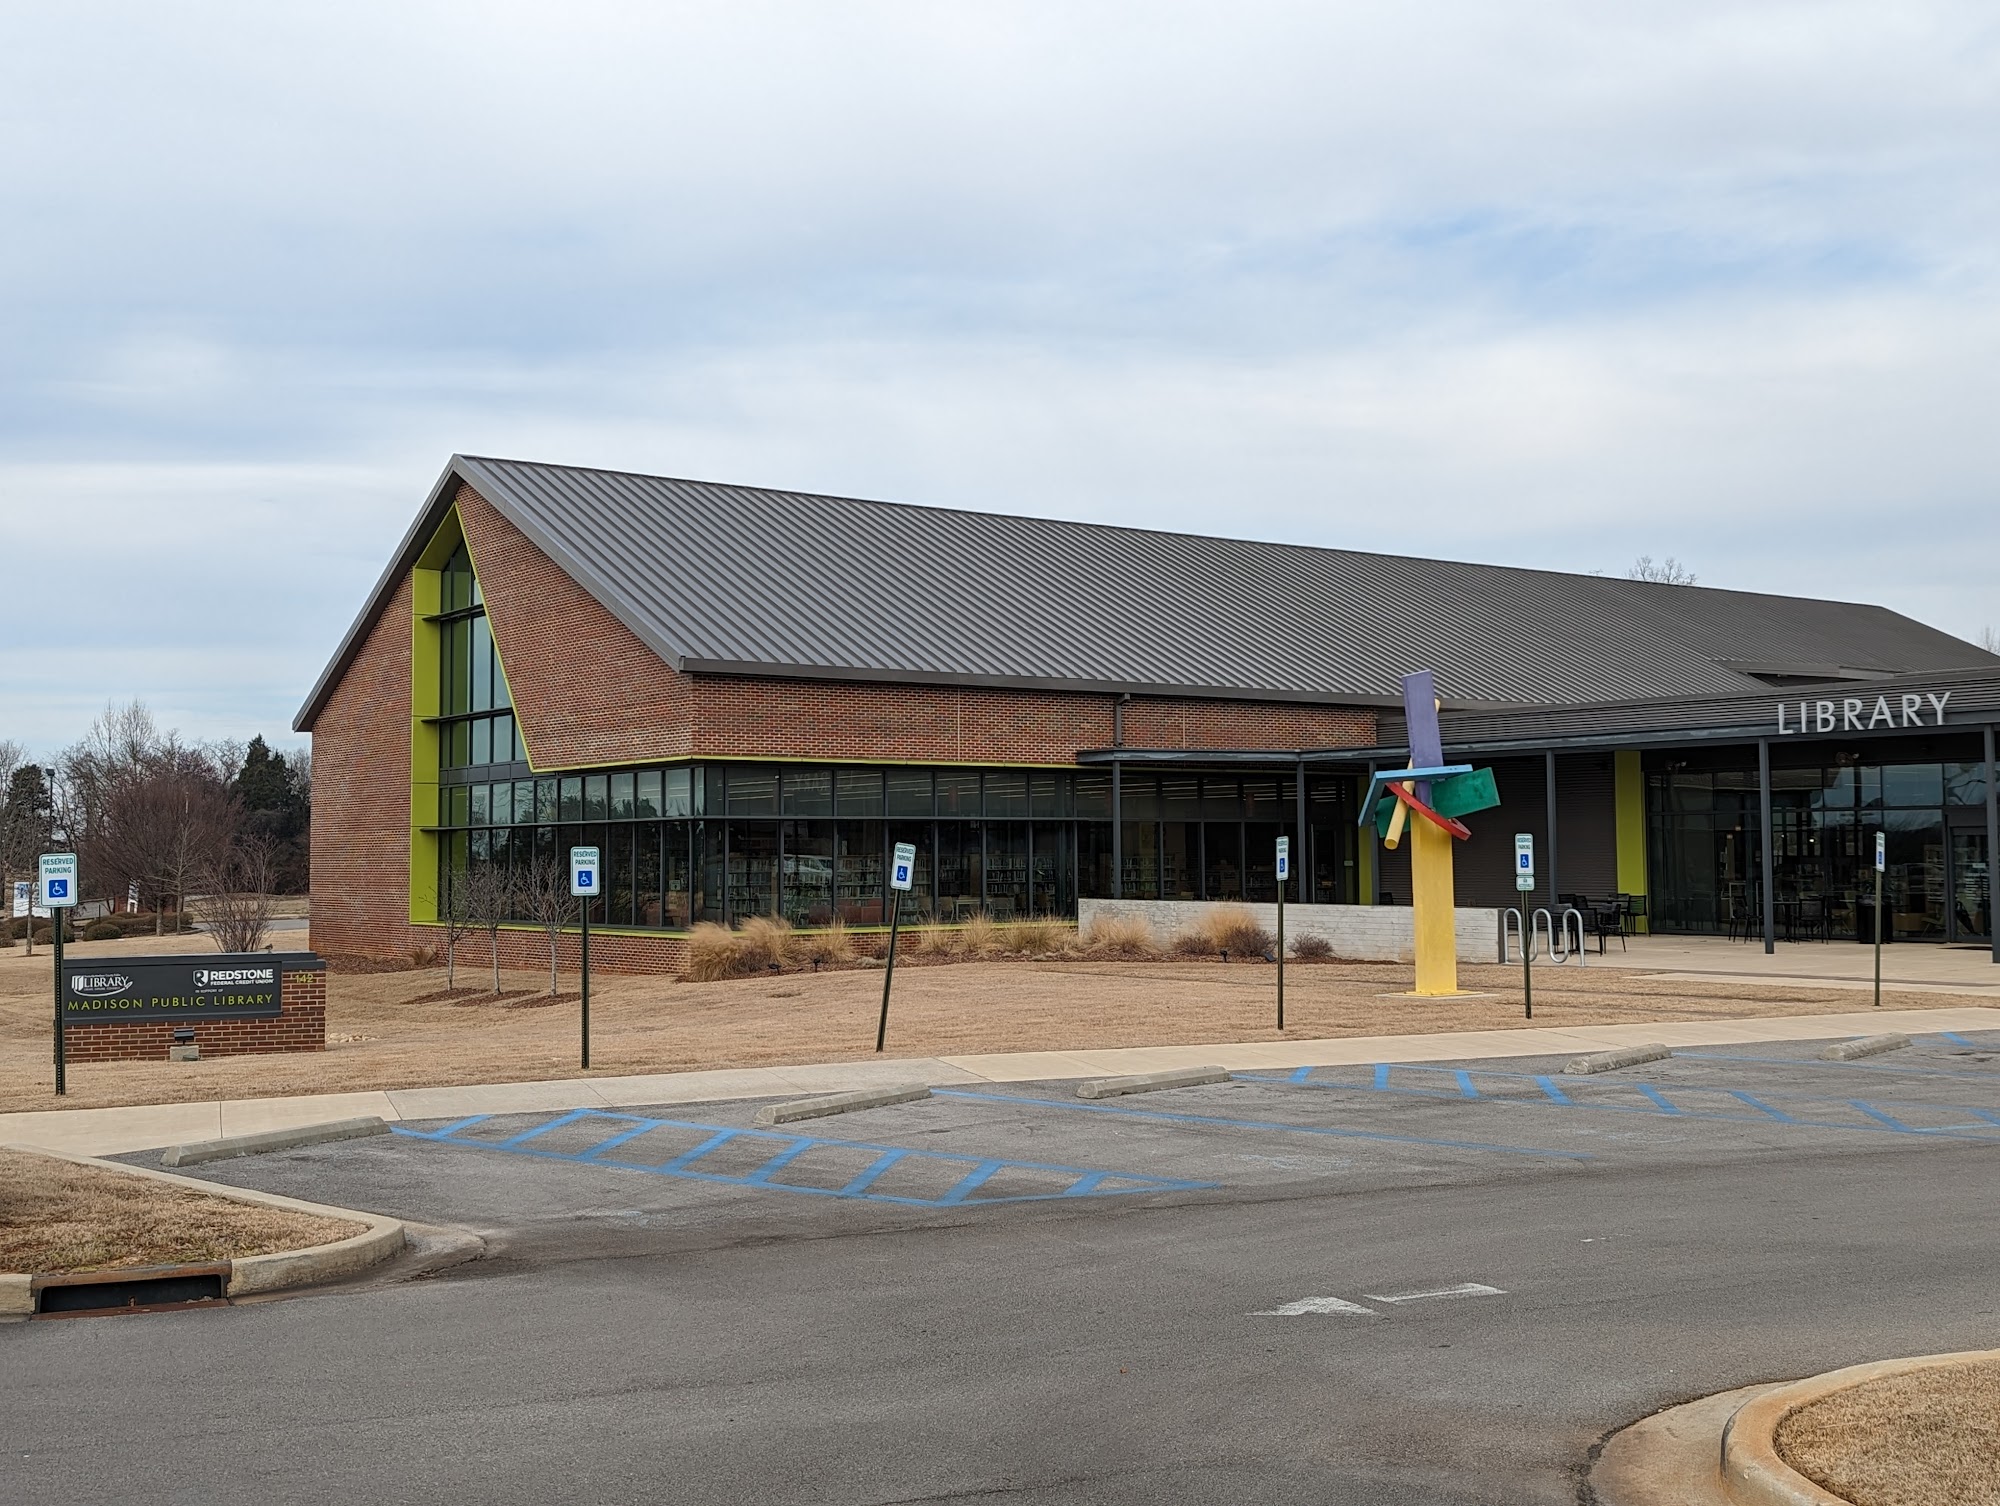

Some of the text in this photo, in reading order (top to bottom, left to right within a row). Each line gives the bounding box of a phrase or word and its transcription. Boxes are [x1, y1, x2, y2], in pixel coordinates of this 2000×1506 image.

[1778, 691, 1951, 734] LIBRARY
[42, 857, 74, 866] RESERVED
[44, 866, 72, 874] PARKING
[210, 969, 274, 980] REDSTONE
[295, 973, 314, 983] 142
[83, 976, 129, 988] LIBRARY
[67, 994, 273, 1011] MADISON PUBLIC LIBRARY
